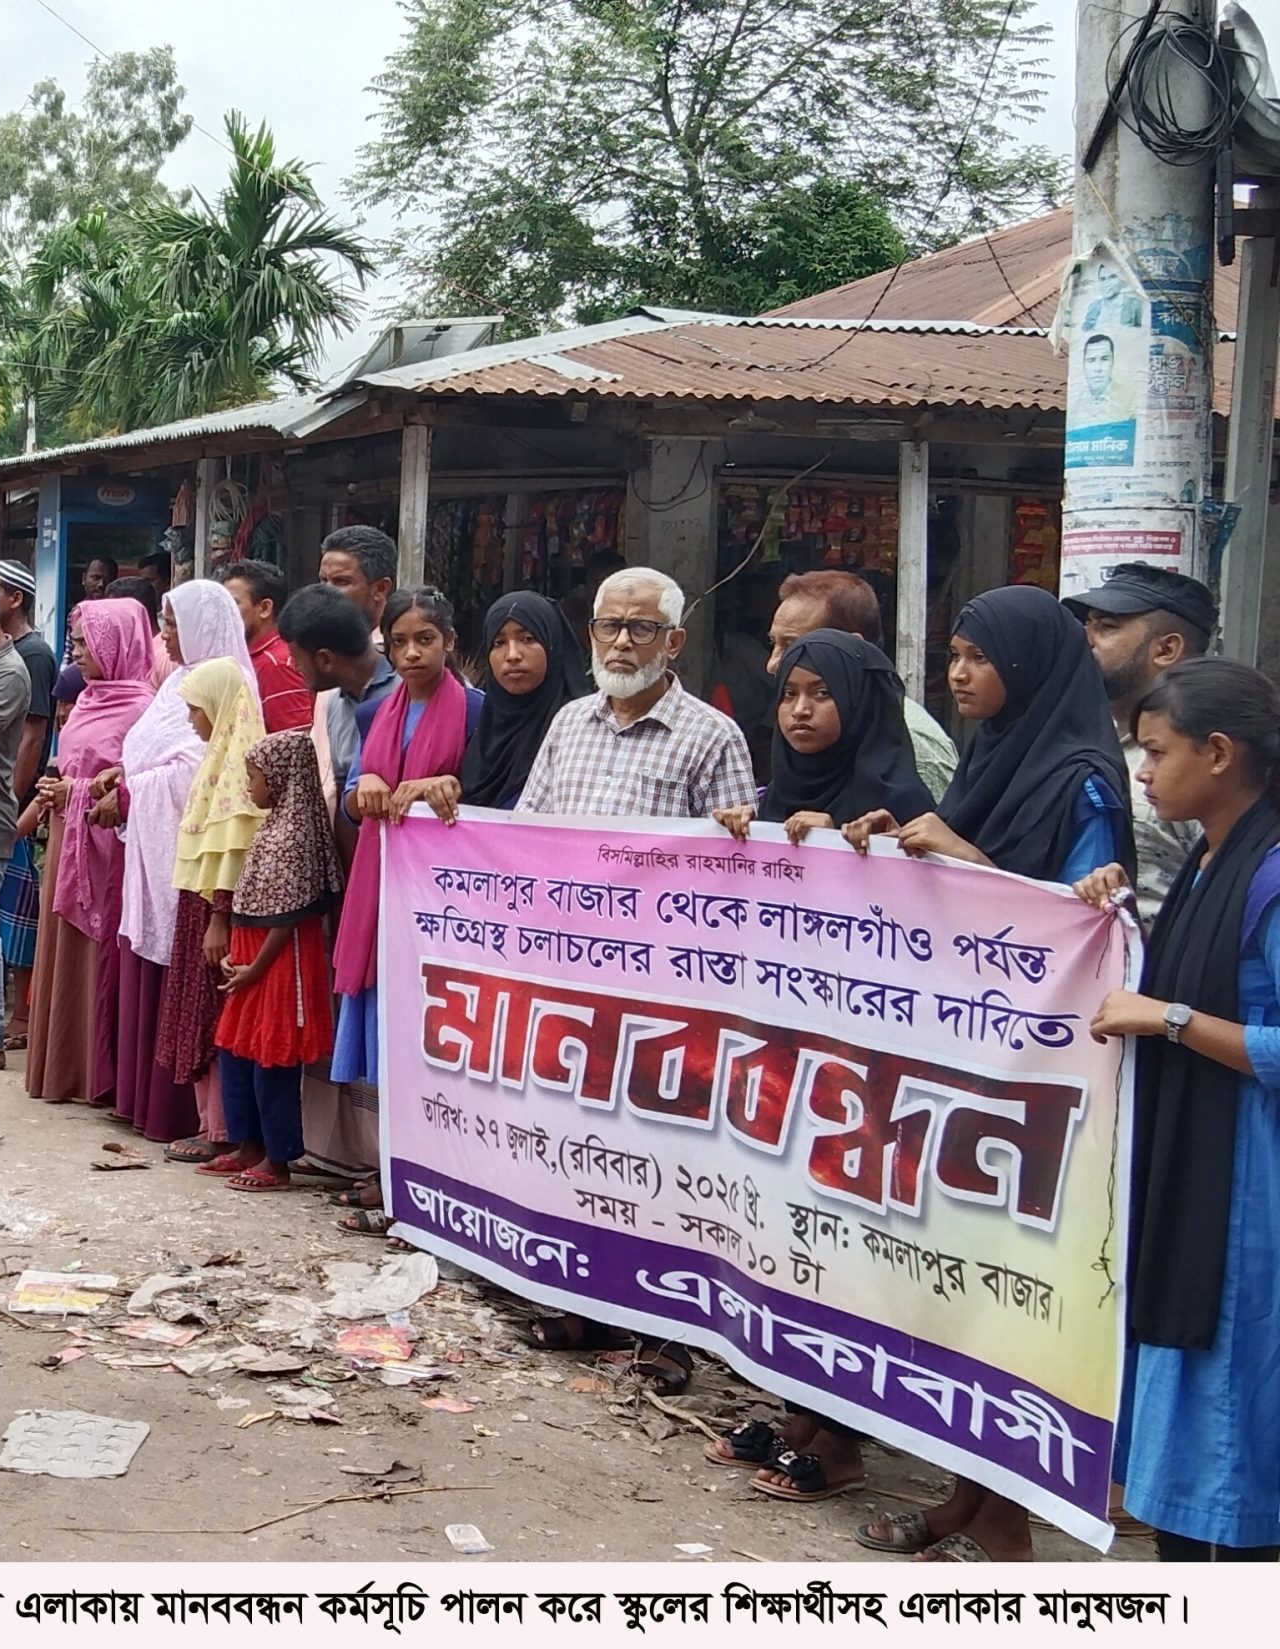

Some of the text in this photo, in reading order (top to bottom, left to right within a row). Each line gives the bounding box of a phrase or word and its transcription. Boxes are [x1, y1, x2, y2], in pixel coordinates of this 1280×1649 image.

[1091, 436, 1129, 453] মানিক
[598, 845, 805, 883] বিসমিল্লাহির রাহমানির রাহিম
[431, 867, 1055, 984] কমলাপুর বাজার থেকে লাঙ্গলগাঁও পর্যন্ত
[517, 926, 655, 976] চলাচলের
[667, 946, 748, 990] রাস্তা
[754, 959, 922, 1026] সংস্কারের
[932, 989, 1082, 1051] দাবিতে
[418, 960, 1085, 1232] মানববন্ধন
[475, 1114, 500, 1149] ২৭
[860, 1222, 967, 1302] কমলাপুর
[574, 1188, 641, 1229] সময়
[676, 1212, 743, 1261] সকাল
[747, 1241, 777, 1277] ১০
[787, 1246, 827, 1296] টা
[636, 1269, 1096, 1487] এলাকাবাসী
